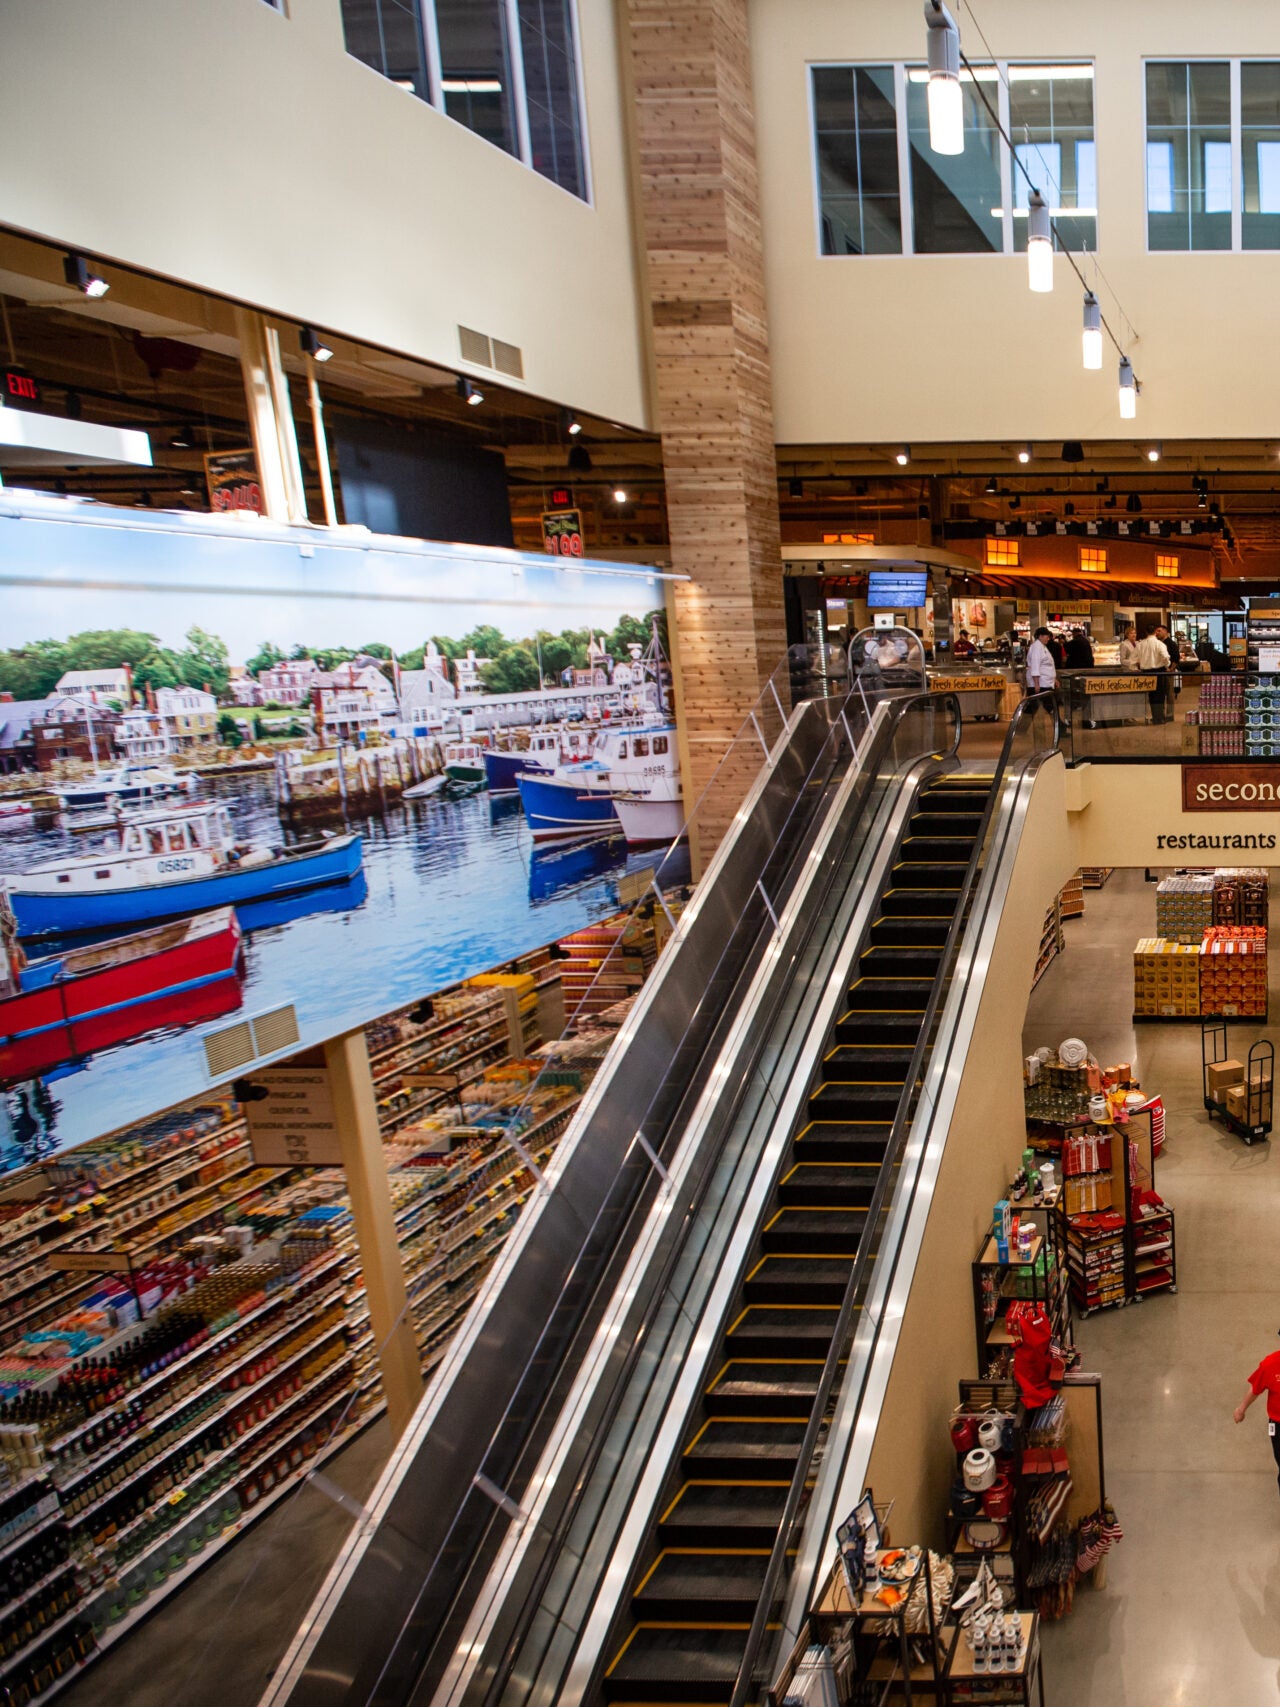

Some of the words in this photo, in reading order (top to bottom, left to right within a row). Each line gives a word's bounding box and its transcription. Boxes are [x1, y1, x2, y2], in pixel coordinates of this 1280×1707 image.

[6, 373, 36, 399] EXIT
[932, 680, 951, 690] Fresh
[953, 678, 979, 689] Seafood
[981, 677, 1003, 688] Market
[1088, 680, 1105, 691] Fresh
[1107, 678, 1131, 690] Seafood
[1133, 678, 1155, 689] Market
[1157, 830, 1276, 849] restaurants
[157, 858, 195, 873] 05821
